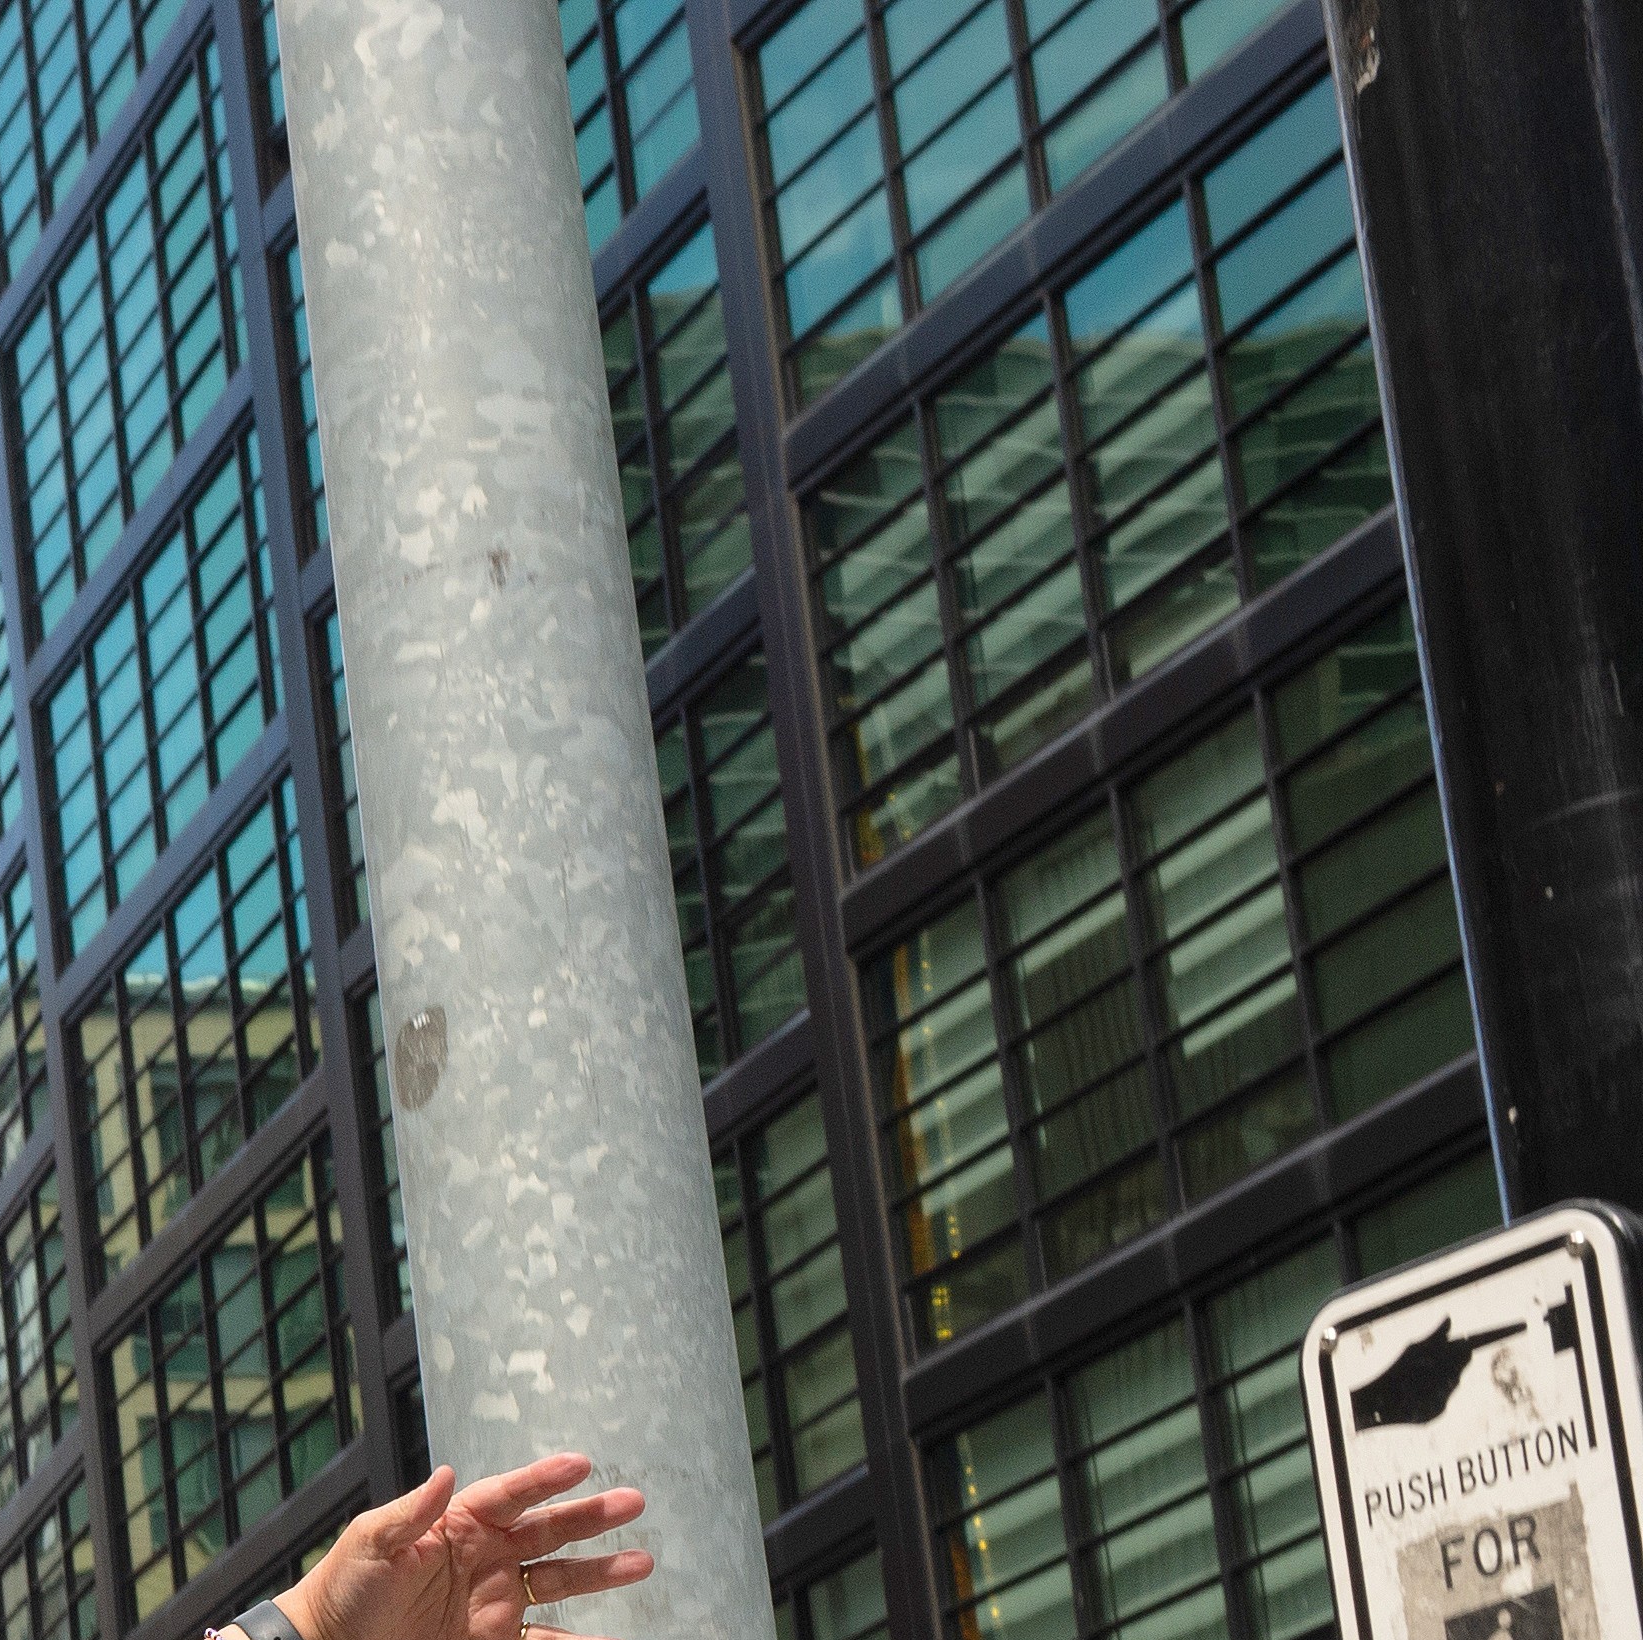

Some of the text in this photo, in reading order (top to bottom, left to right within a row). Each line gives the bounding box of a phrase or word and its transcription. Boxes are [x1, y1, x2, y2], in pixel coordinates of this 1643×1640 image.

[1365, 1417, 1579, 1529] PUSH BUTTON
[1439, 1512, 1541, 1591] FOR
